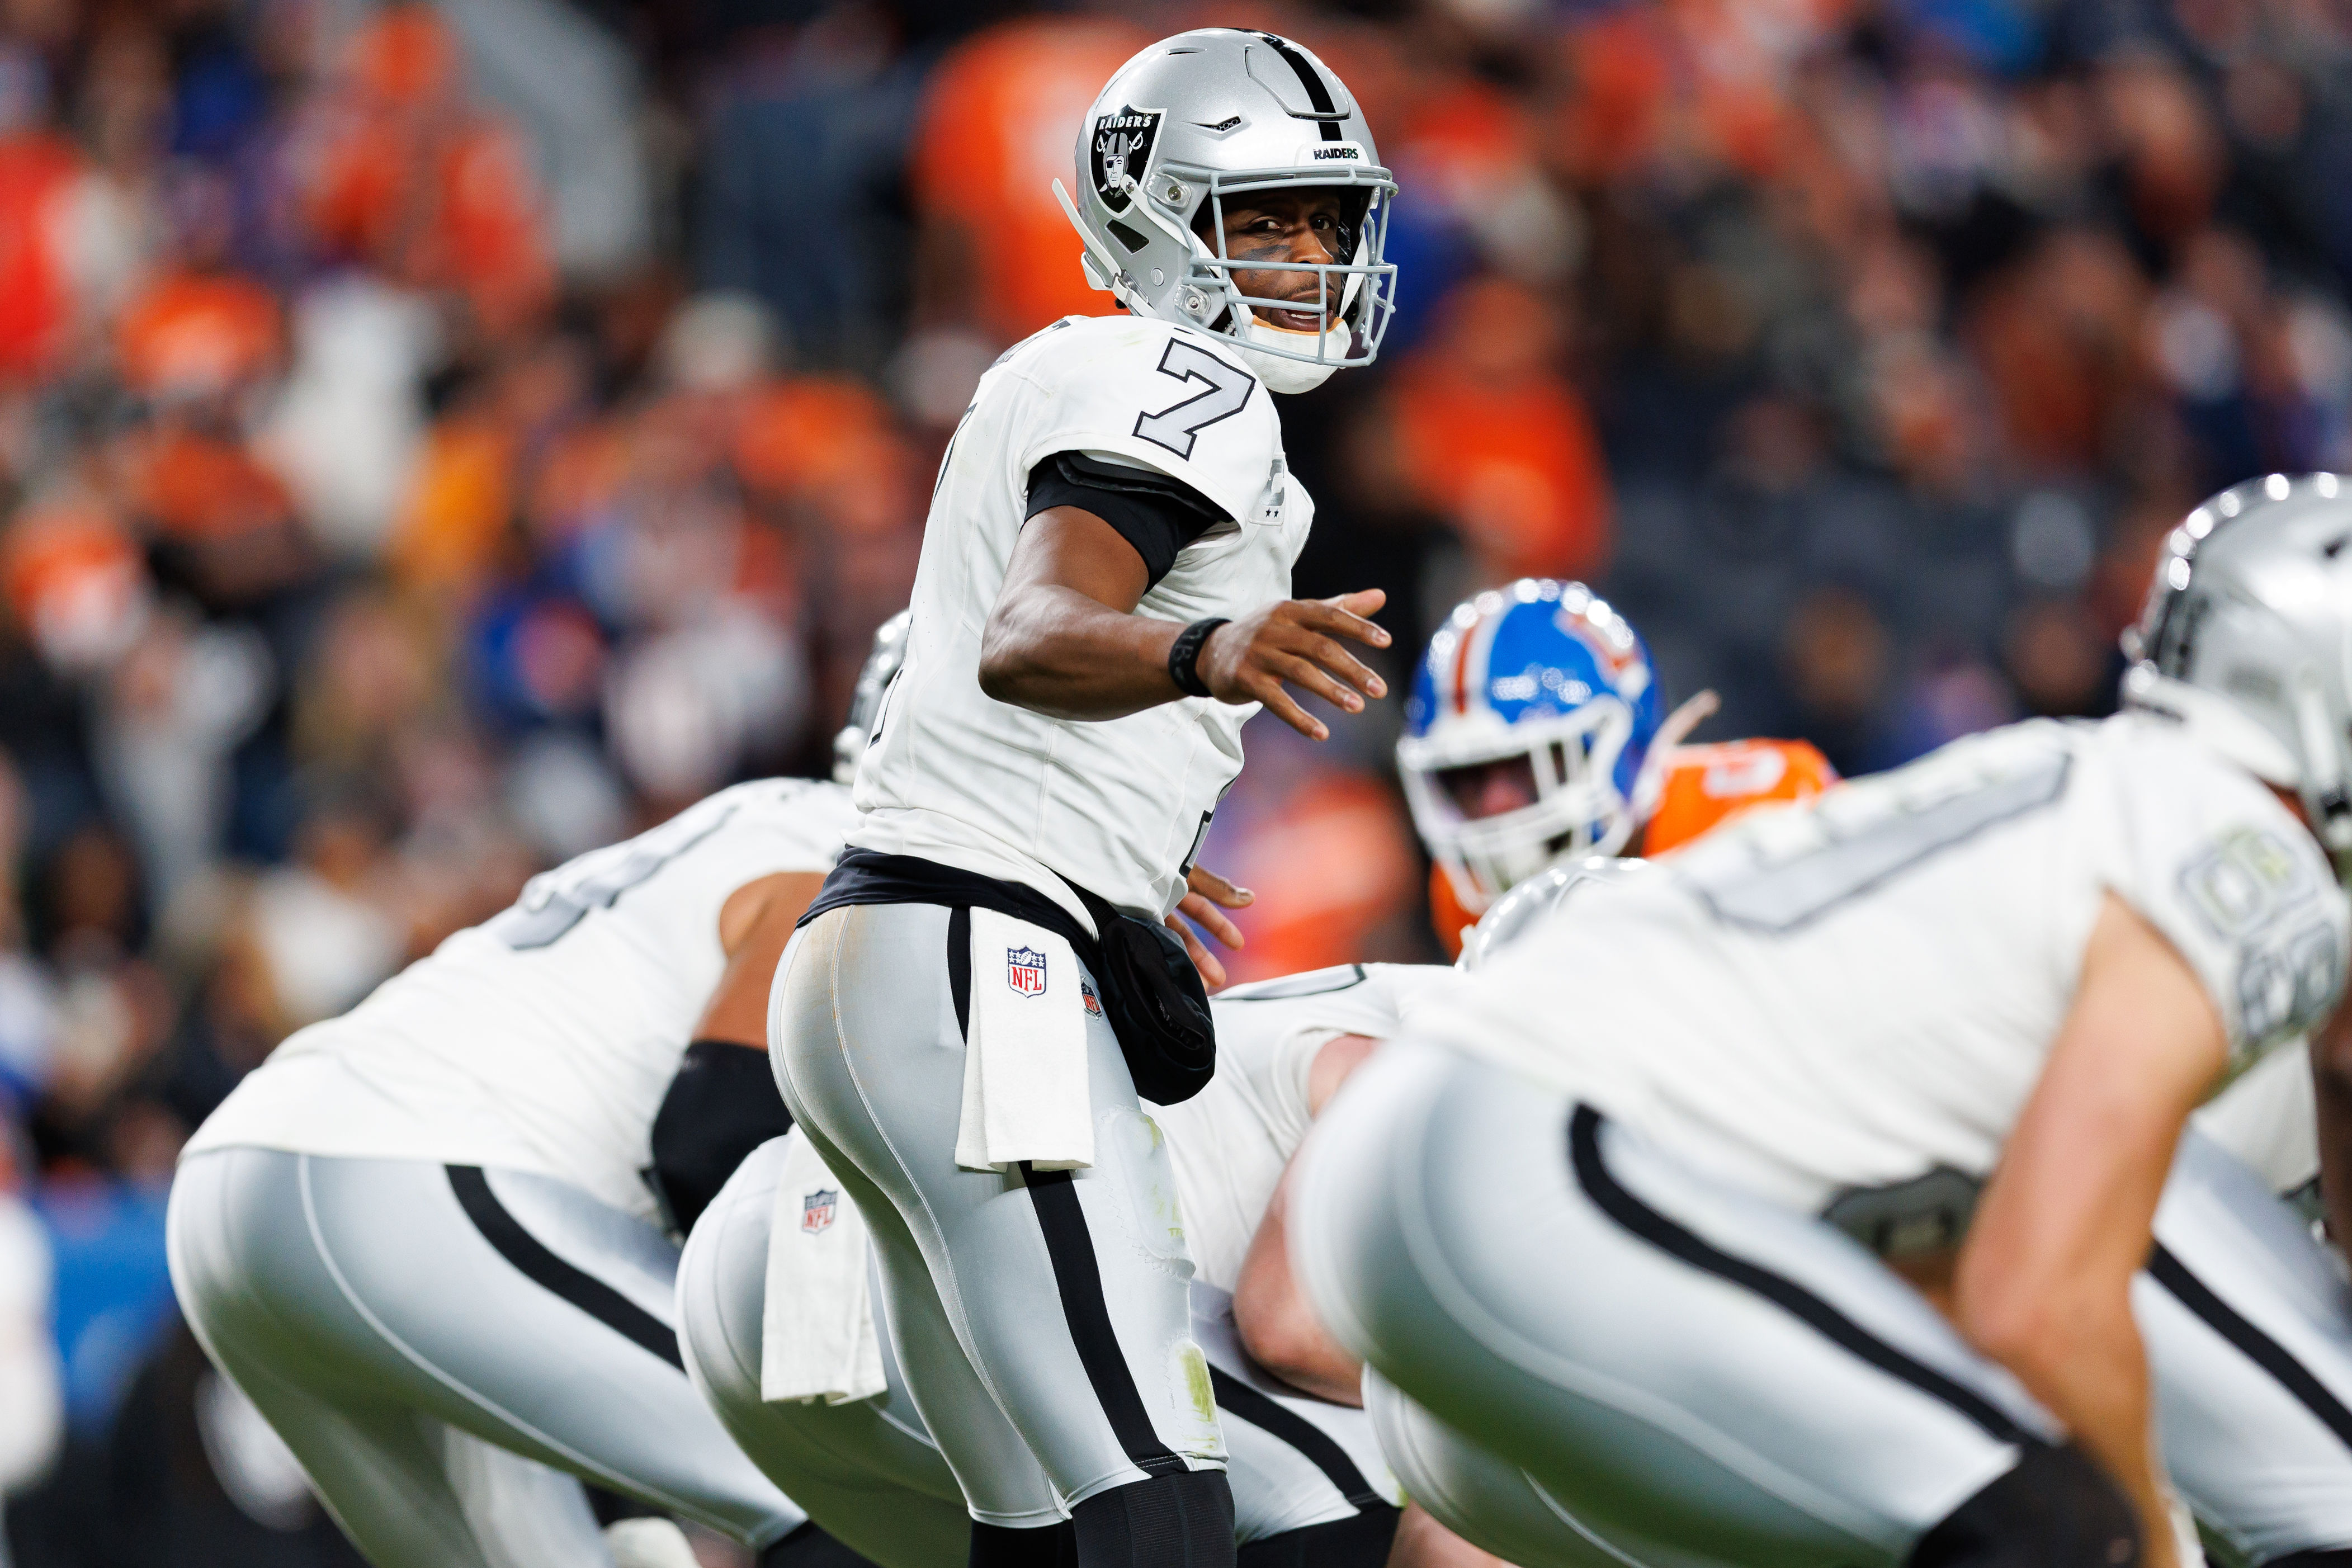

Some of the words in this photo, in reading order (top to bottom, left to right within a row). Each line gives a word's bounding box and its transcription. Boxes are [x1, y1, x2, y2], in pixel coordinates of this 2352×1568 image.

[1099, 115, 1153, 130] RAIDERS
[1313, 148, 1358, 159] RAIDERS
[1132, 337, 1257, 461] 7
[1012, 966, 1042, 992] NFL
[1083, 994, 1100, 1013] NFL
